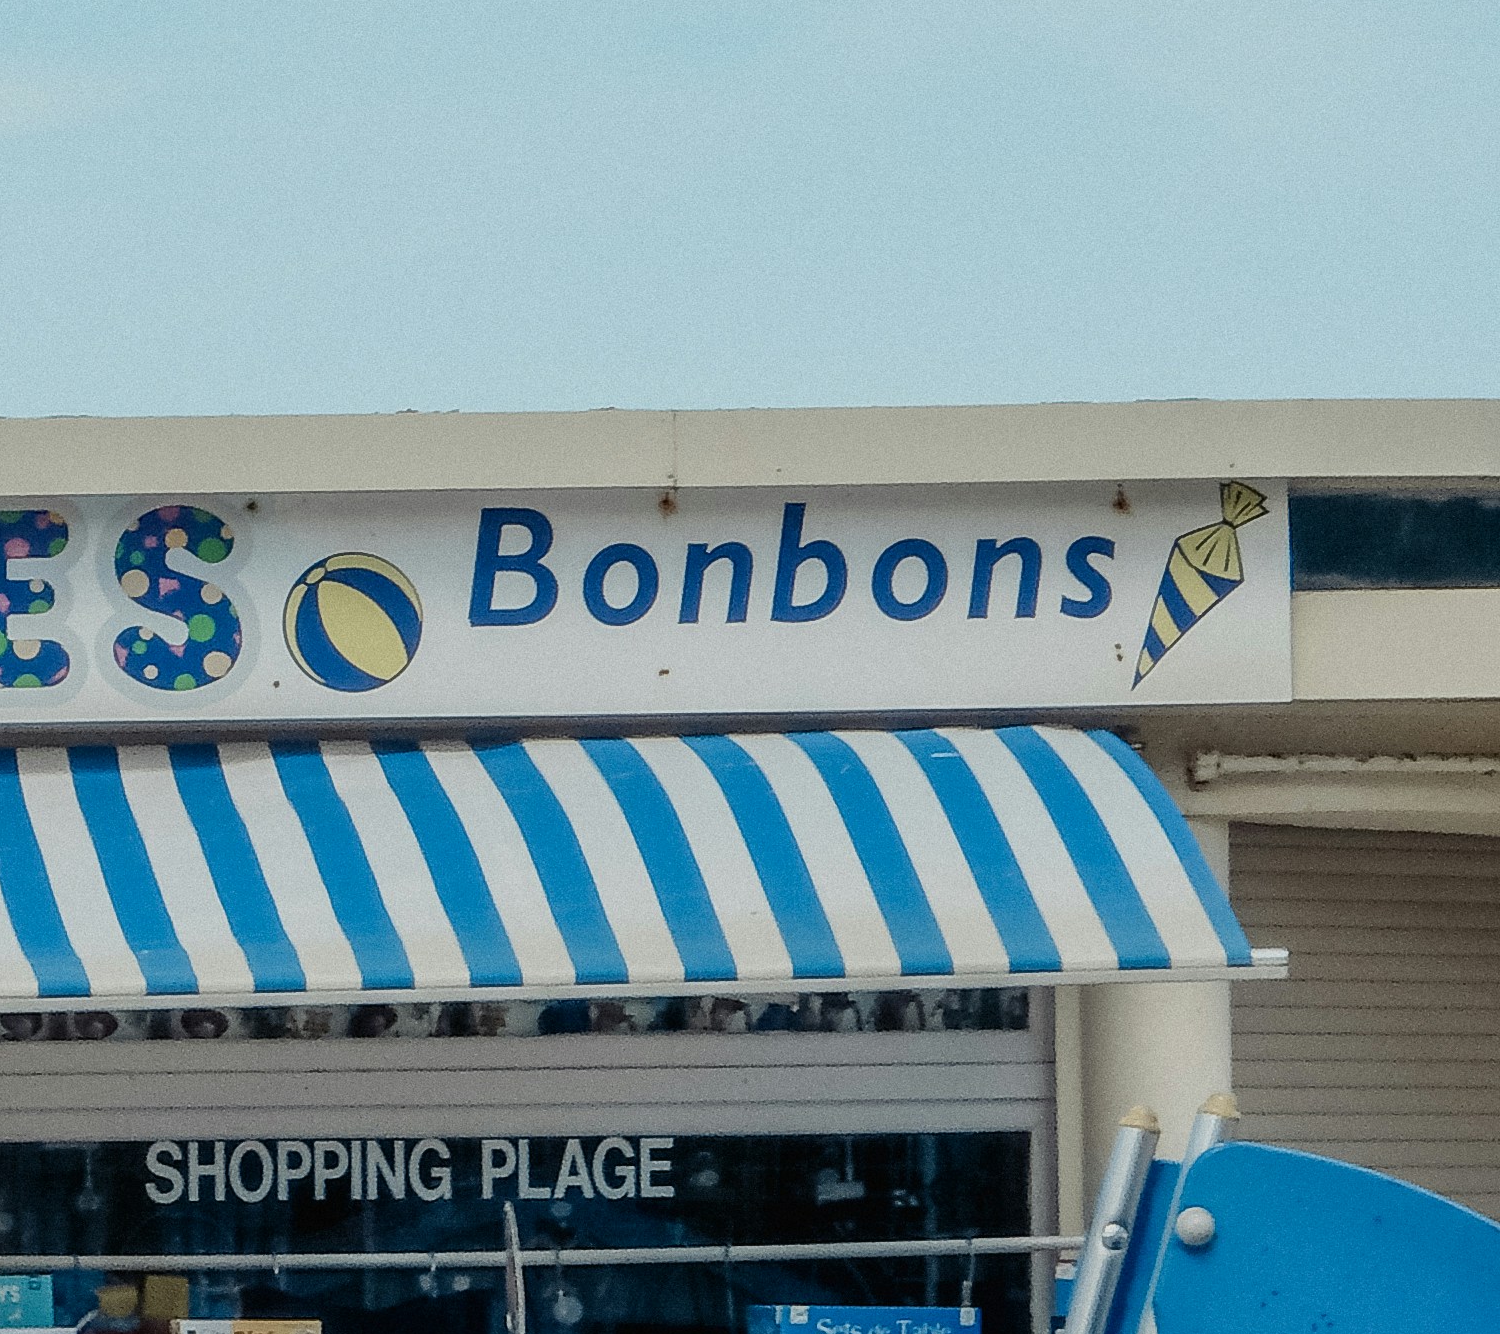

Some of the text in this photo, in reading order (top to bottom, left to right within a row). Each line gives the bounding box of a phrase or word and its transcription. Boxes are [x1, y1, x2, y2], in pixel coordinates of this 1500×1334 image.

[467, 503, 1118, 628] Bonbons
[144, 1136, 676, 1204] SHOPPING PLAGE
